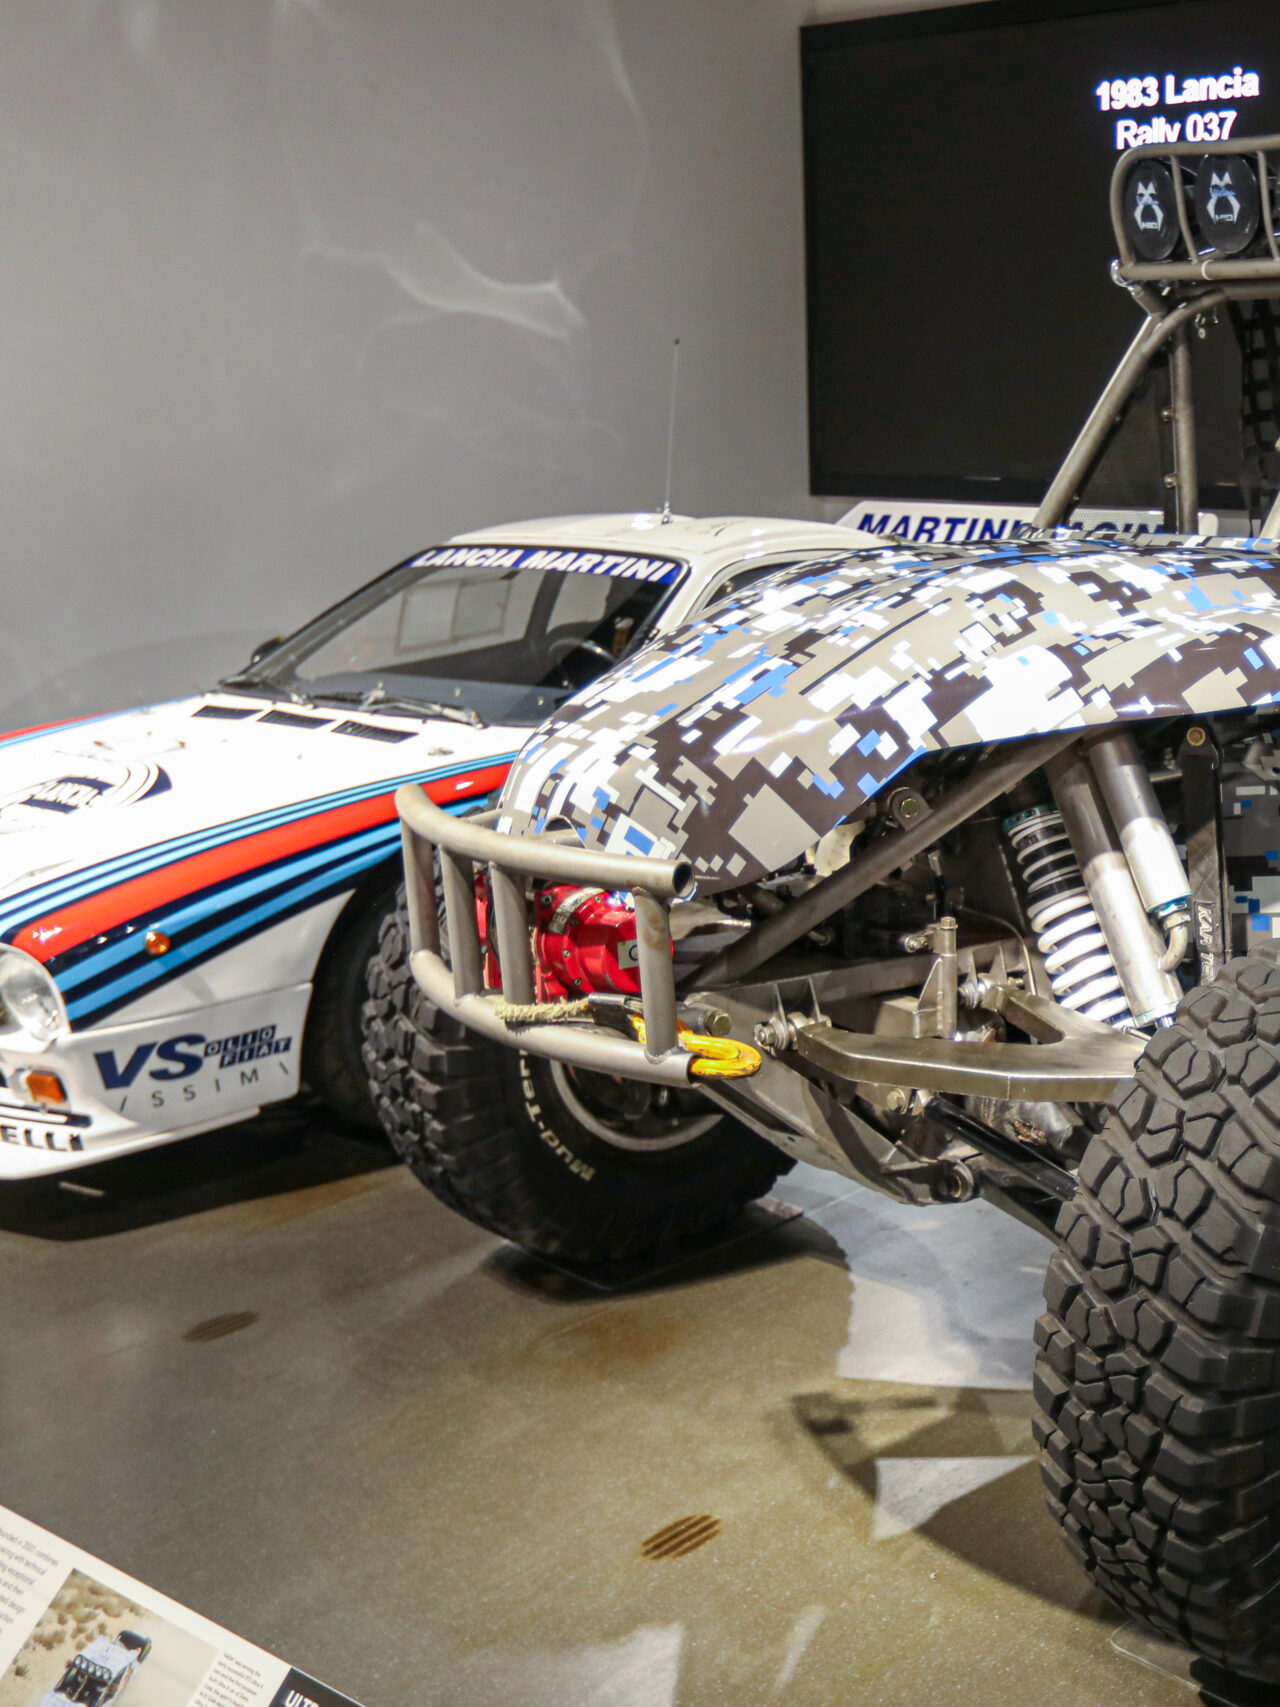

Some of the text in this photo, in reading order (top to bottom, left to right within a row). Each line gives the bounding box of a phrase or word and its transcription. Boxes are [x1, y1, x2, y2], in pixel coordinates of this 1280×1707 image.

[1095, 66, 1260, 111] 1983 Lancia
[1115, 109, 1238, 150] Rally 037
[411, 548, 677, 583] LANCIA MARTINI
[205, 1025, 276, 1056] OLIO
[220, 1037, 291, 1068] FIAT
[93, 1034, 206, 1090] VS
